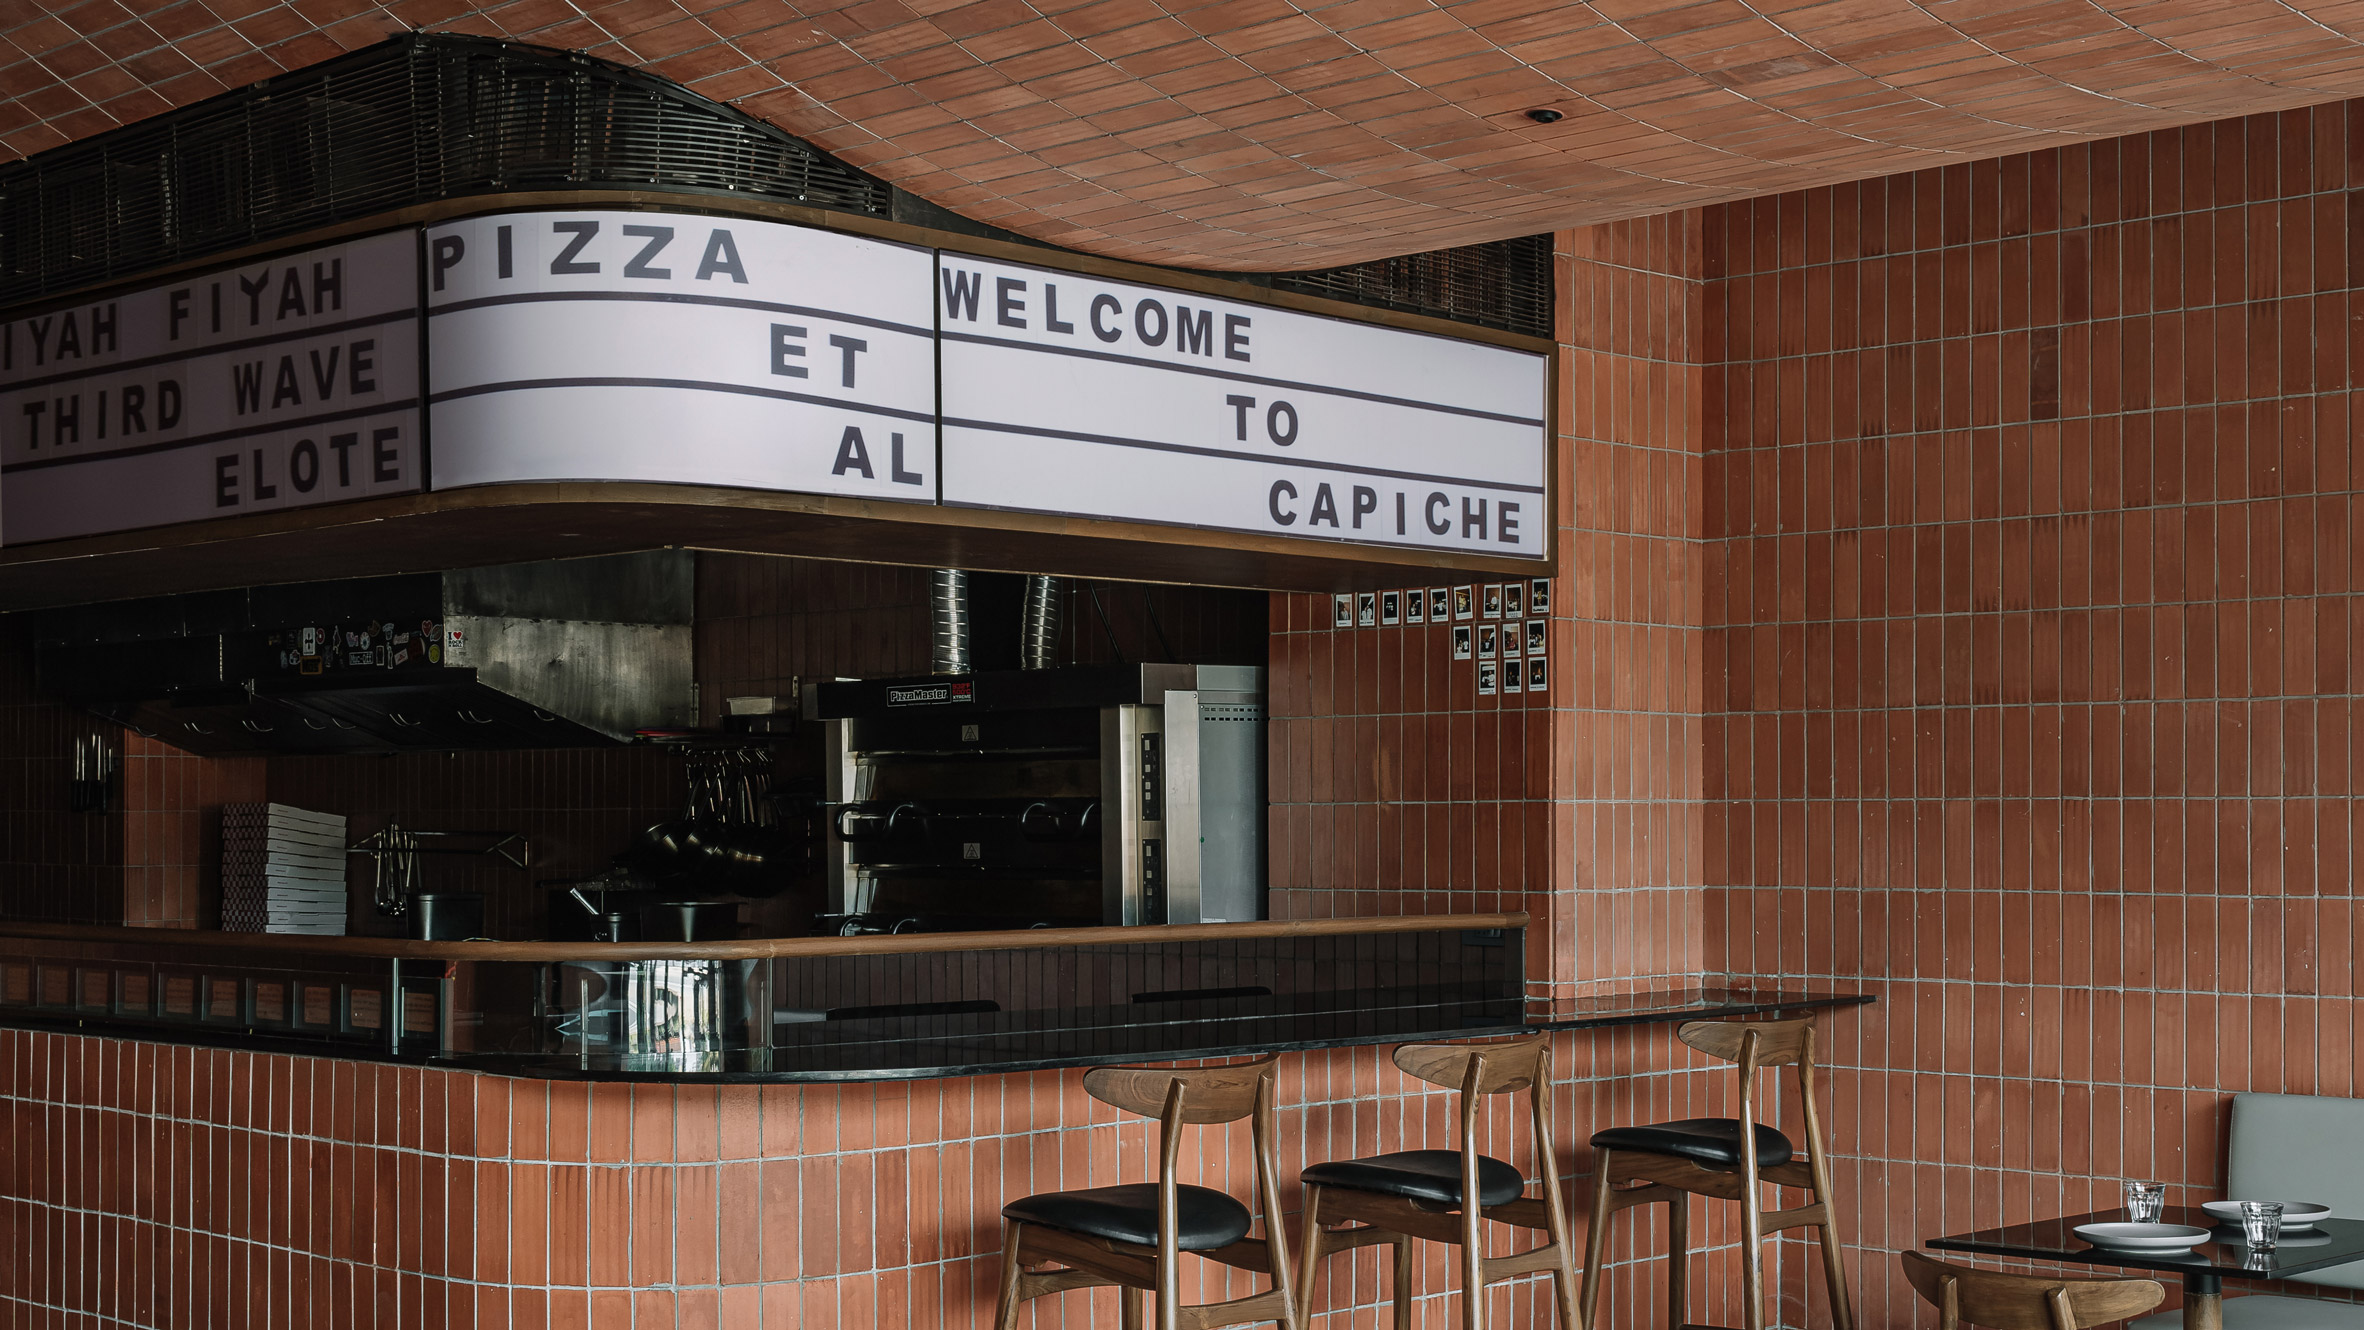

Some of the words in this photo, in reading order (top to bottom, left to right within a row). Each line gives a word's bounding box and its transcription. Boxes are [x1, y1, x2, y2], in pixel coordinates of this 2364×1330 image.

[433, 220, 749, 292] PIZZA
[169, 258, 342, 341] FIYAH
[942, 267, 1252, 362] WELCOME
[770, 322, 867, 389] ET
[23, 379, 182, 450] THIRD
[233, 338, 376, 416] WAVE
[1227, 394, 1299, 447] TO
[216, 426, 400, 508] ELOTE
[832, 426, 923, 486] AL
[1269, 479, 1521, 544] CAPICHE
[890, 688, 948, 702] PizzaMaster
